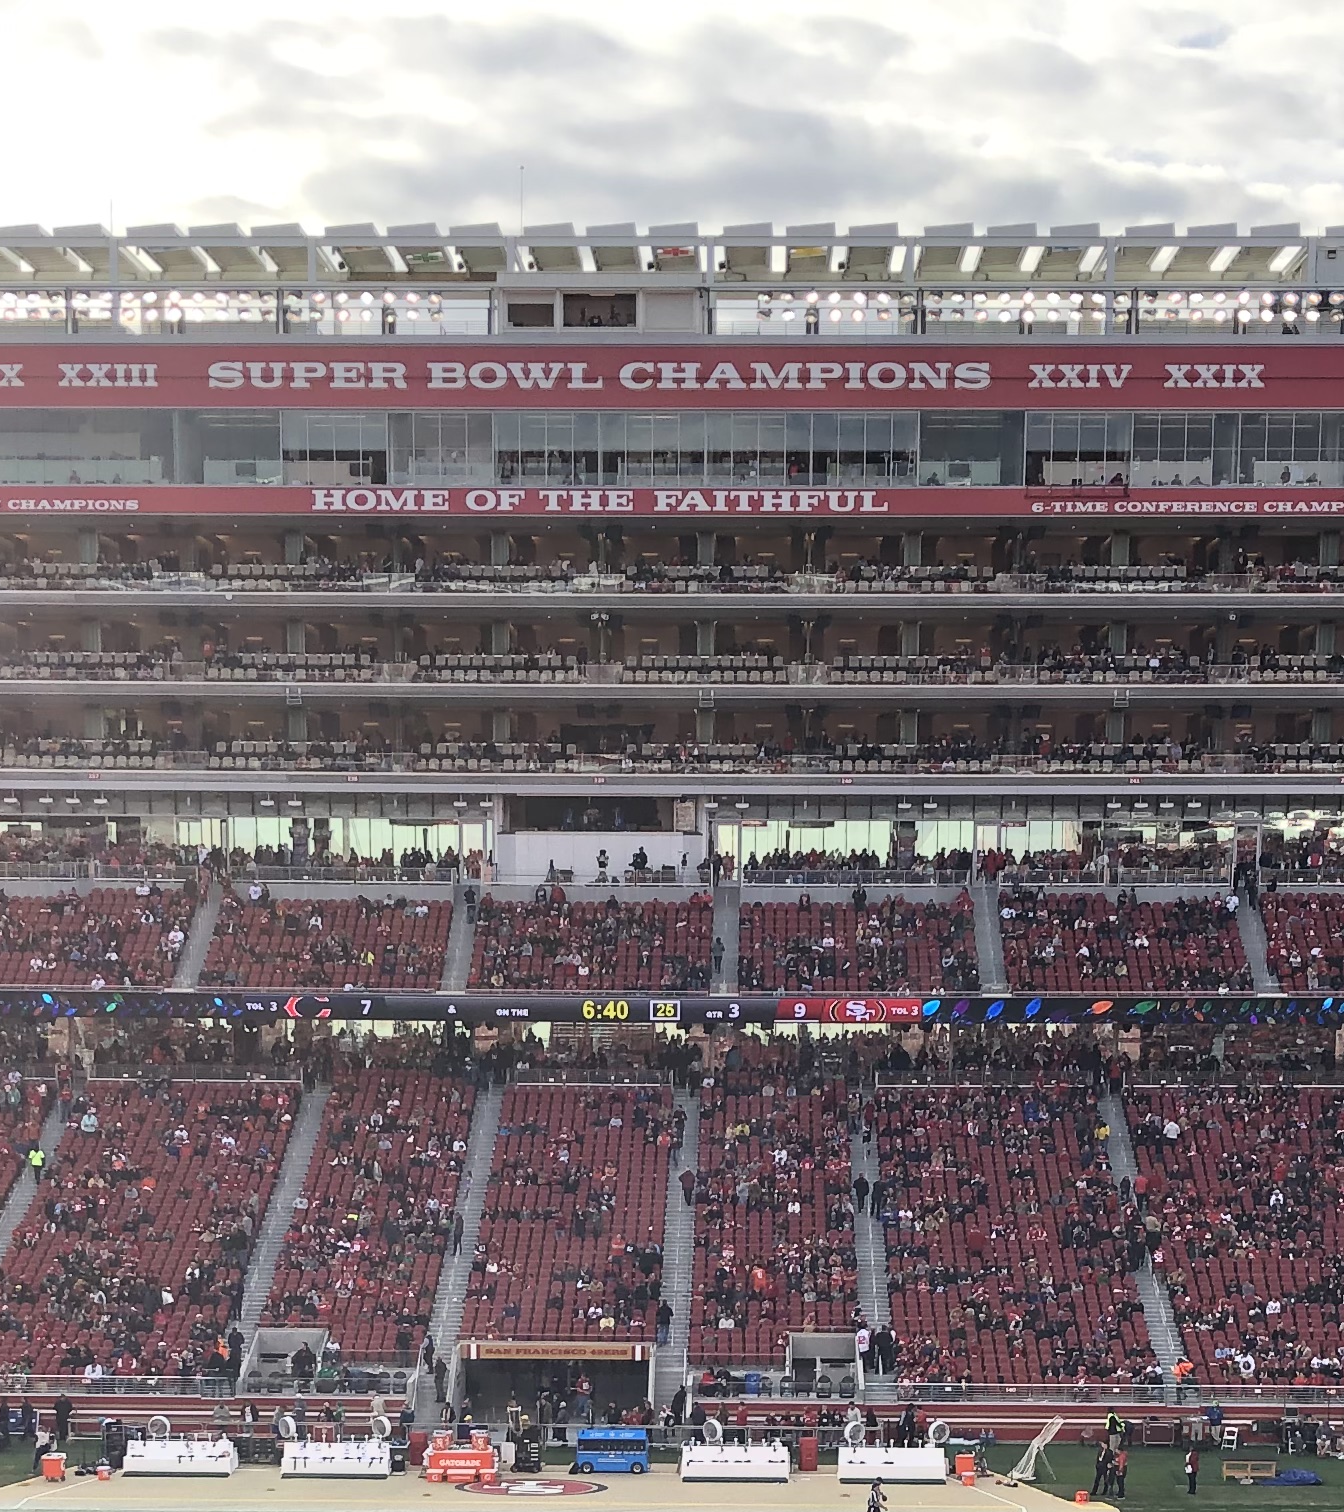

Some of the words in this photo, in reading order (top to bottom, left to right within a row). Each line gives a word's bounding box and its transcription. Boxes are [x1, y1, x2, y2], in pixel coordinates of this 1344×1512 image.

[58, 363, 158, 387] XXIII
[207, 361, 408, 389] SUPER
[426, 361, 603, 390] BOWL
[618, 361, 991, 390] CHAMPIONS
[1027, 364, 1133, 388] XXIV
[1163, 364, 1265, 388] XXIX
[7, 498, 140, 511] CHAMPIONS
[311, 489, 456, 511] HOME
[465, 489, 524, 511] OF
[537, 489, 635, 511] THE
[653, 489, 889, 512] FAITHFUL
[1031, 501, 1108, 514] 6-TIME
[1113, 501, 1258, 514] CONFERENCE
[360, 1000, 372, 1014] 7
[583, 1001, 629, 1020] 6:40
[729, 1004, 740, 1018] 3
[794, 1003, 806, 1017] 9
[911, 1006, 919, 1016] 3
[484, 1348, 512, 1356] SAN
[516, 1348, 587, 1356] FRANCISCO
[591, 1348, 628, 1356] 49ERS
[439, 1458, 481, 1467] GATORADE
